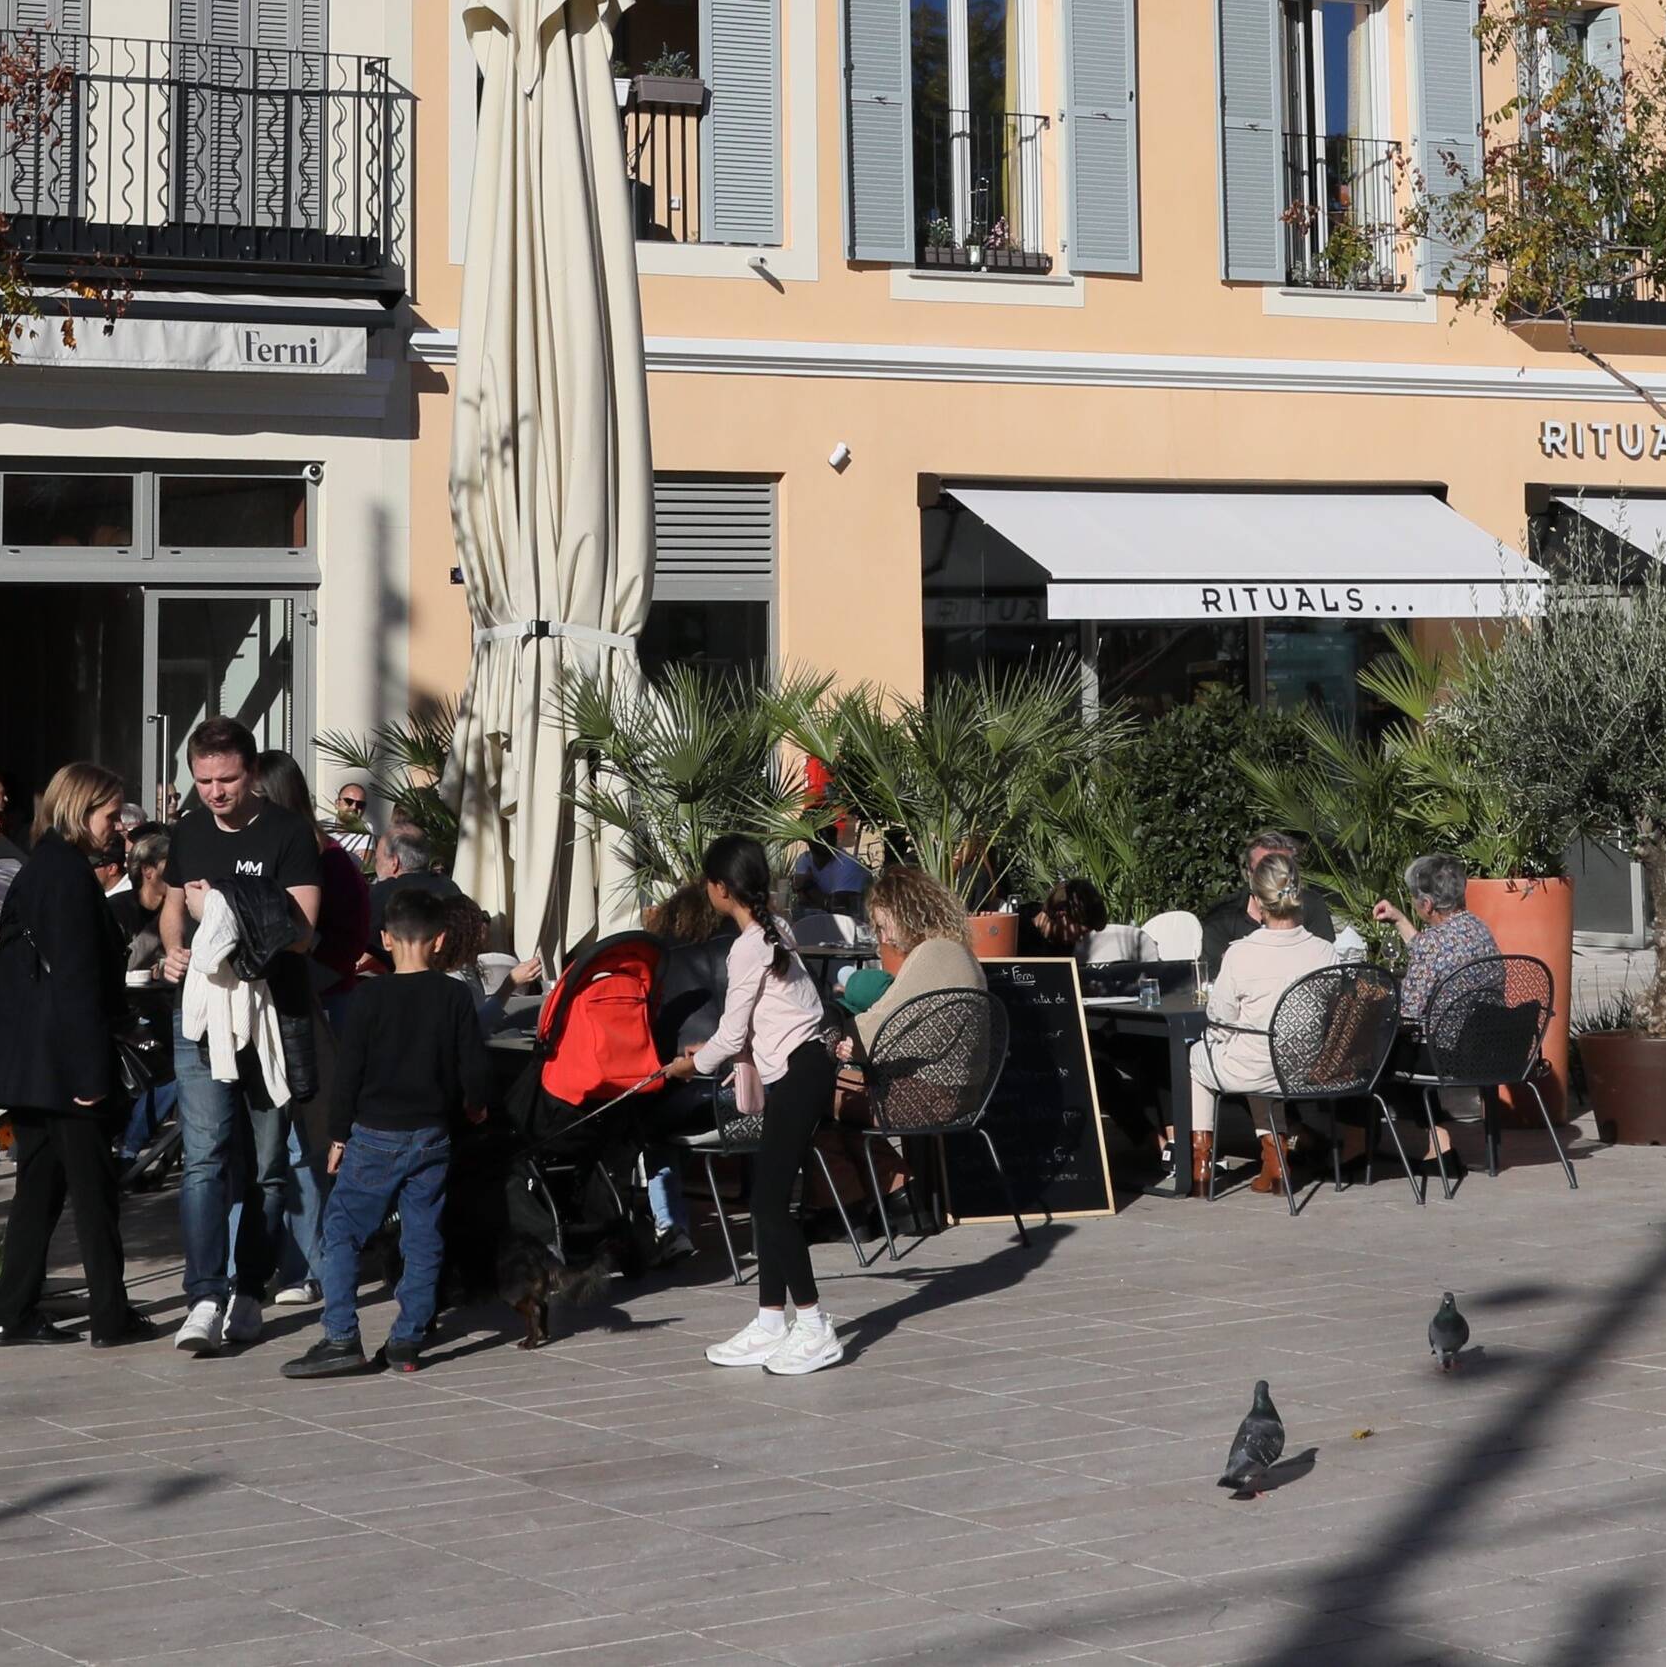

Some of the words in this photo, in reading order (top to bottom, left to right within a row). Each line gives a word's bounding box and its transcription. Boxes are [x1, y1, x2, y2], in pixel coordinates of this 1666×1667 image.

[244, 330, 318, 364] Ferni
[1201, 587, 1414, 612] RITUALS...
[235, 859, 263, 876] MM
